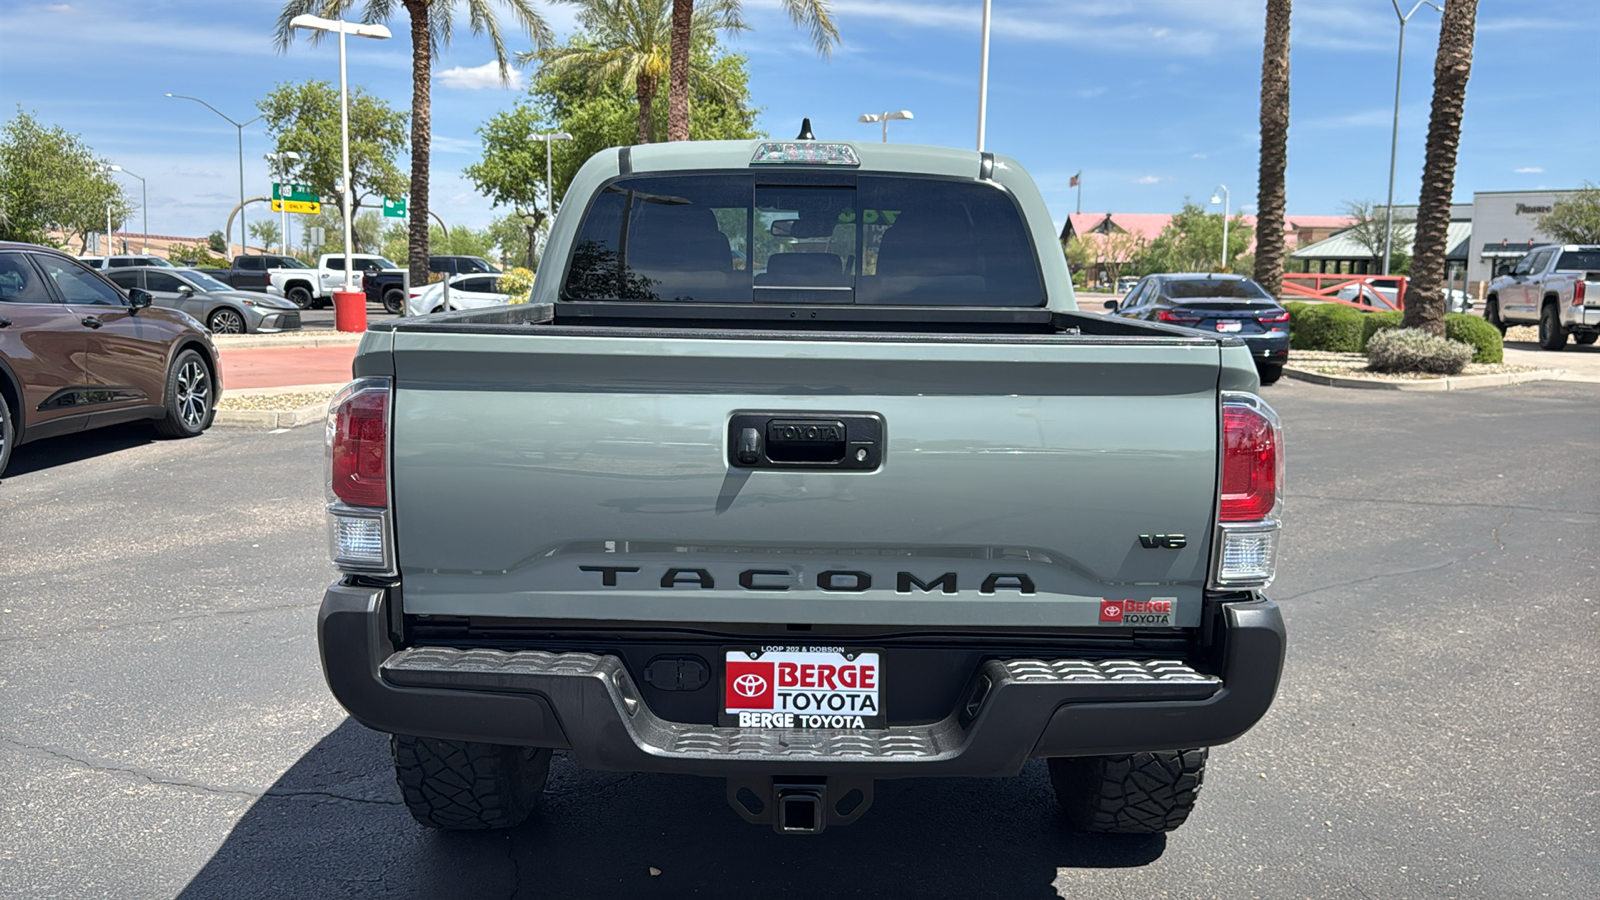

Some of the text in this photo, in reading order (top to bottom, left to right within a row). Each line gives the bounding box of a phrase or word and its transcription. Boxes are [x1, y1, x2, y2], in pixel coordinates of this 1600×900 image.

[773, 426, 840, 440] TOYOTA
[1138, 533, 1187, 549] V6
[578, 565, 1036, 593] TACOMA
[1123, 599, 1171, 613] BERGE
[1124, 614, 1170, 624] TOYOTA
[761, 645, 784, 653] LOOP
[786, 645, 800, 653] 202
[809, 646, 845, 654] DOBSON
[777, 662, 876, 691] BERGE
[777, 692, 877, 712] TOYOTA
[738, 711, 866, 729] BERGE TOYOTA
